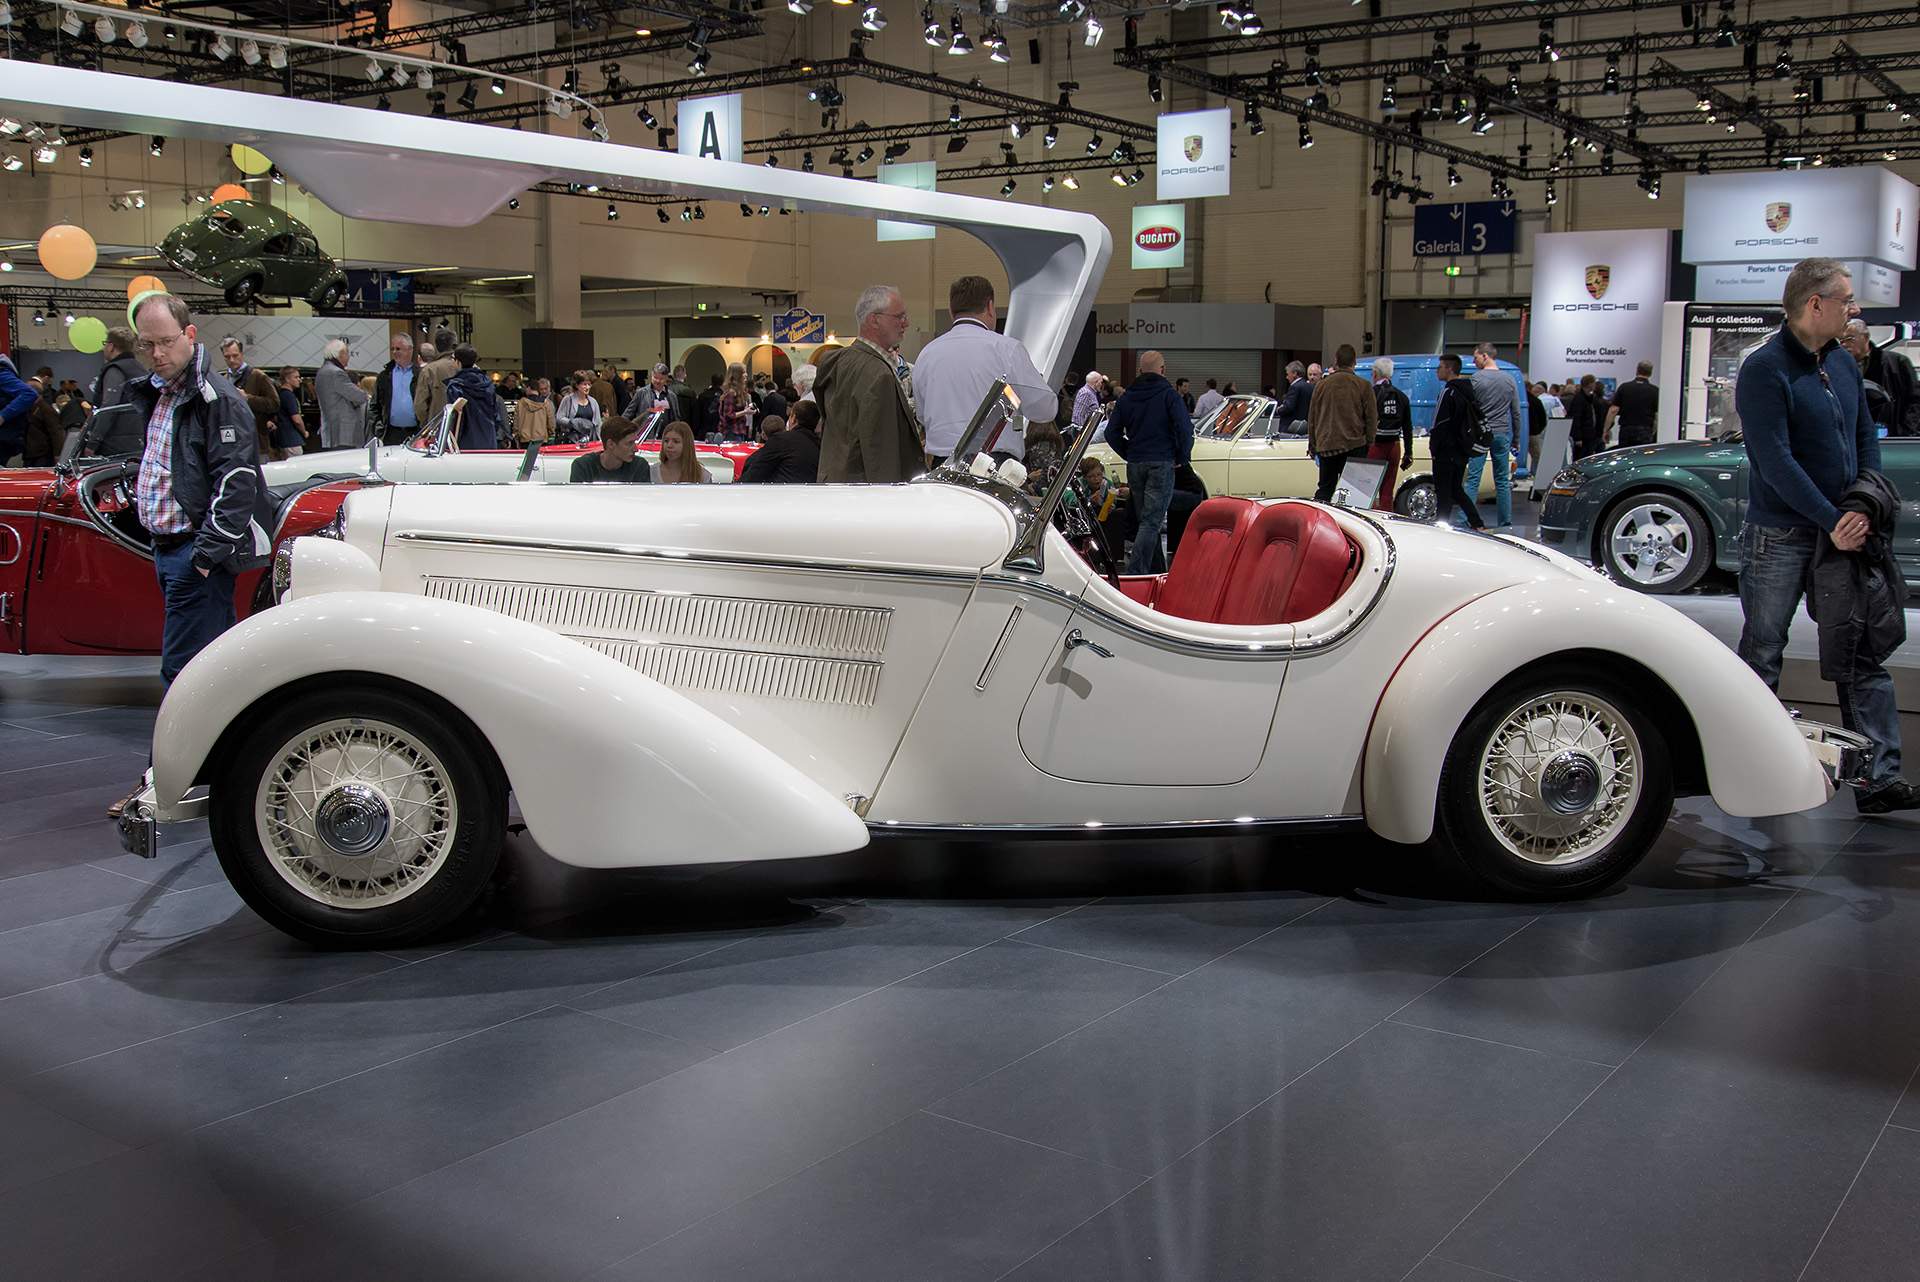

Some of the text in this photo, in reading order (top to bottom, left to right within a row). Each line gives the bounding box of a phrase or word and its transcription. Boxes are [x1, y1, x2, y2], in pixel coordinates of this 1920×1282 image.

[699, 111, 722, 160] A
[1161, 164, 1225, 176] PORSCHE
[1139, 232, 1176, 245] BUGATTI
[1471, 223, 1488, 252] 3
[1735, 237, 1819, 247] PORSCHE
[1415, 240, 1461, 254] Galeria
[1552, 303, 1639, 312] PORSCHE
[1691, 315, 1764, 324] Audi collection
[1566, 347, 1628, 356] Porsche Classic
[1384, 405, 1397, 415] 85
